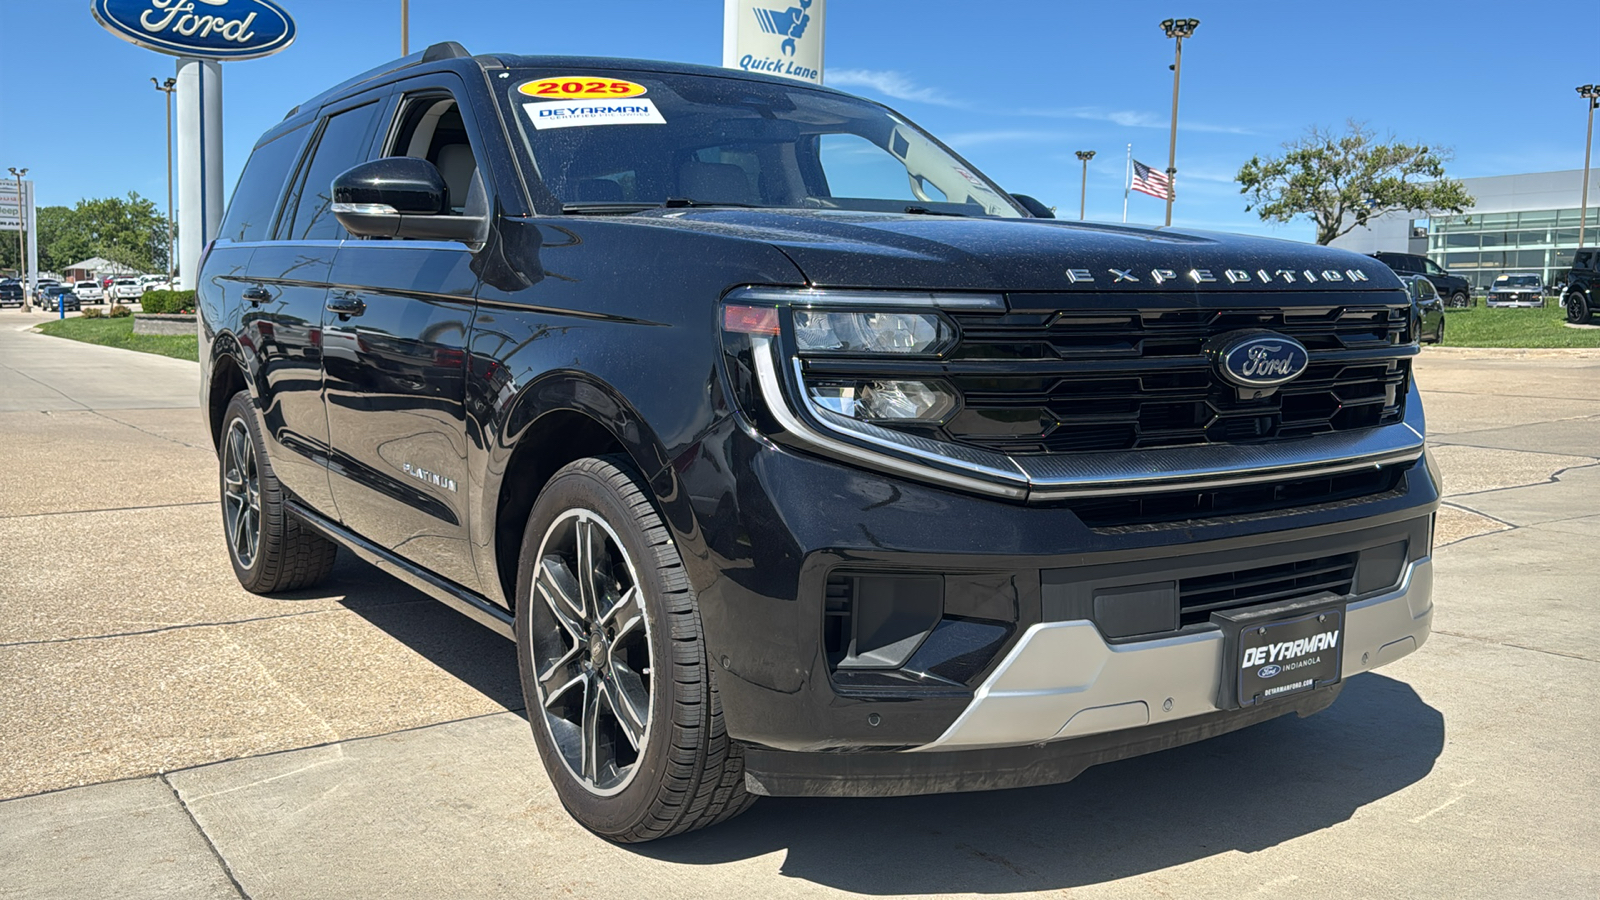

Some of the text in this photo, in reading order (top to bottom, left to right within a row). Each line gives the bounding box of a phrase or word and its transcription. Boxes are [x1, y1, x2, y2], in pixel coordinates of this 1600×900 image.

[140, 0, 258, 43] Ford
[739, 54, 818, 80] Quick Lane
[536, 82, 632, 95] 2025
[539, 106, 649, 118] DEYARMAN
[0, 206, 19, 216] eep
[1065, 268, 1370, 284] EXPEDITION
[1242, 344, 1296, 377] Ford
[402, 462, 458, 493] PLATINUM
[1242, 630, 1339, 669] DEYARMAN
[1282, 656, 1321, 672] INDIANOLA
